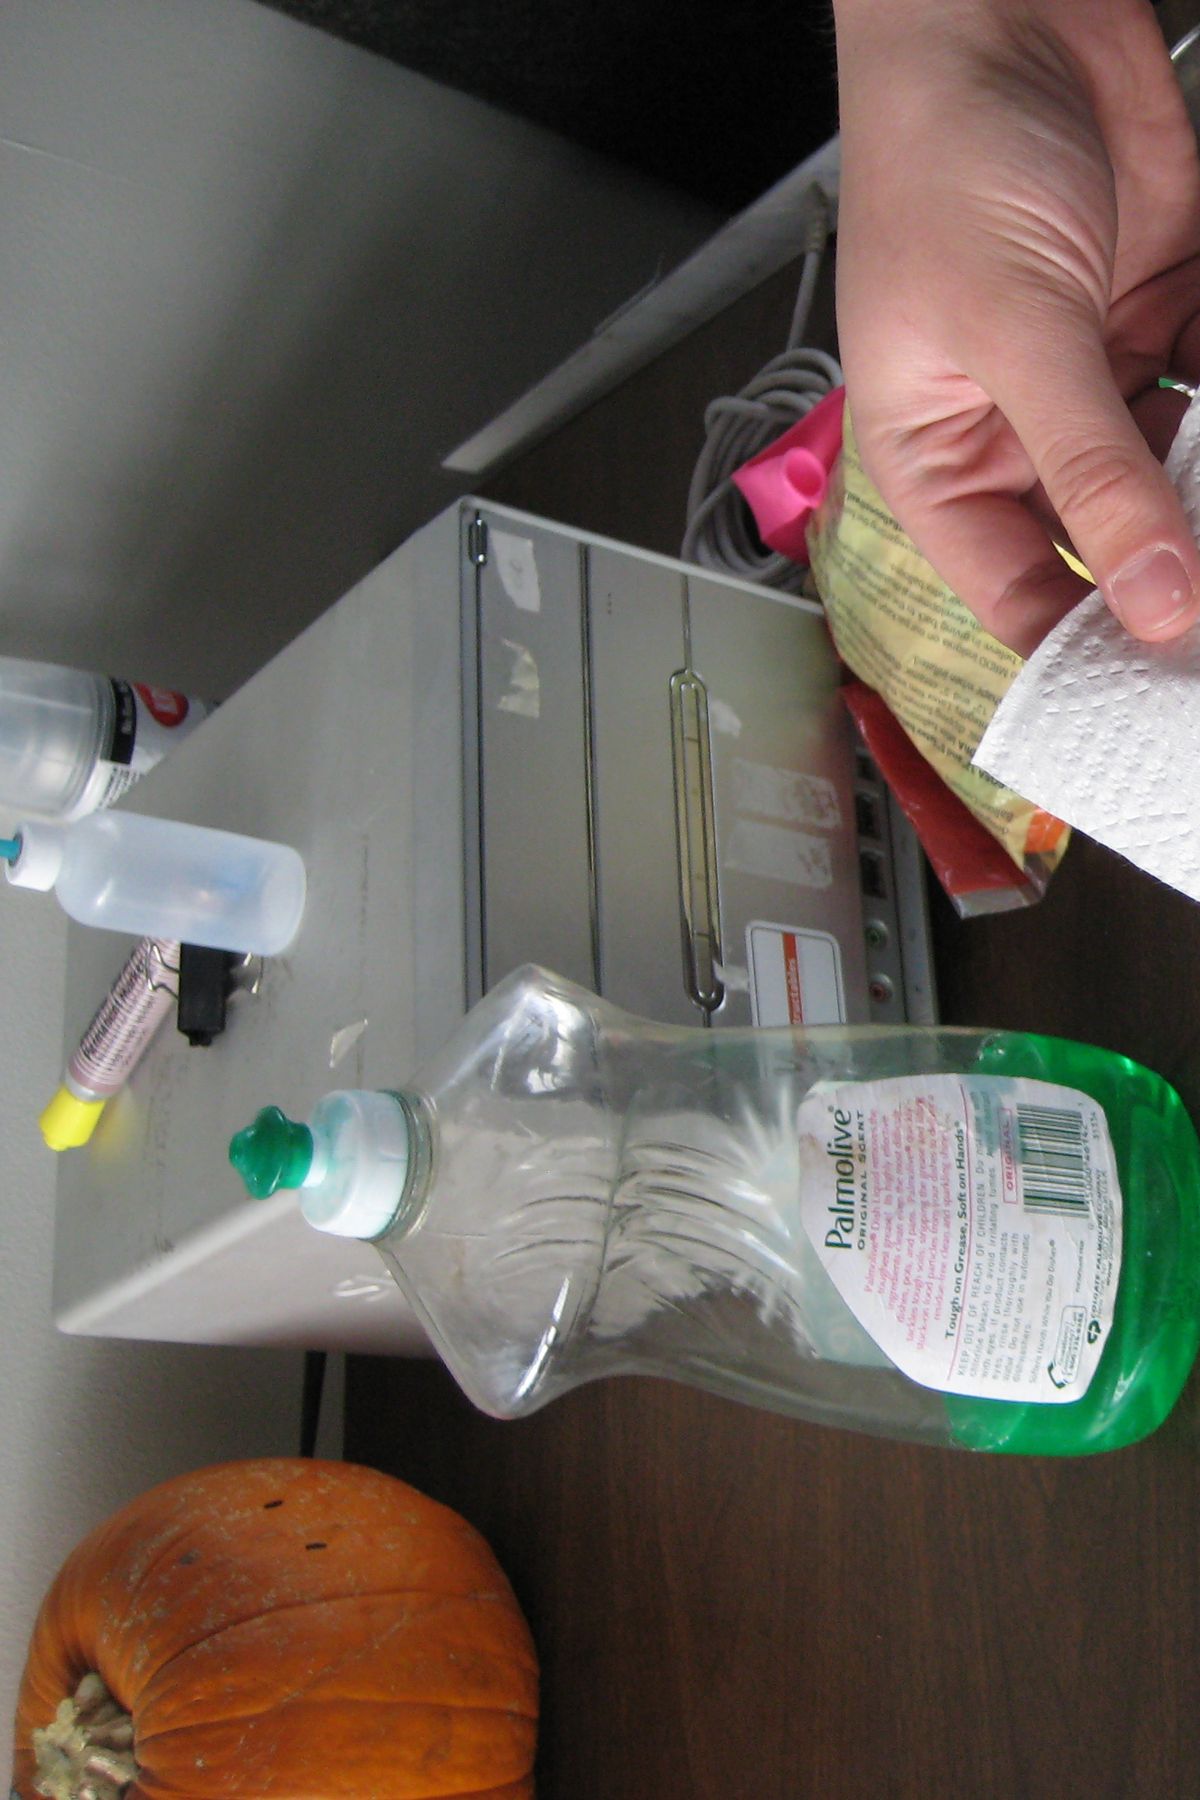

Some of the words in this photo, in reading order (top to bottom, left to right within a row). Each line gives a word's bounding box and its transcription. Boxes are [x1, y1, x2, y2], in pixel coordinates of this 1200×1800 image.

[916, 609, 940, 628] back
[868, 1108, 878, 1123] the
[856, 1108, 866, 1163] SCENT
[871, 1126, 879, 1168] removes
[917, 1126, 926, 1144] and
[975, 1137, 983, 1155] not
[918, 1148, 928, 1178] grease
[930, 1150, 938, 1181] dishes
[975, 1159, 984, 1174] Do
[1002, 1119, 1013, 1190] ORIGINAL
[824, 1108, 855, 1249] Palmolive
[871, 1170, 884, 1202] Liquid
[883, 1161, 893, 1190] highly
[919, 1181, 927, 1197] the
[941, 1161, 952, 1206] sparkling
[957, 1172, 966, 1188] on
[857, 1170, 867, 1249] ORIGINAL
[871, 1207, 880, 1229] Dish
[957, 1191, 967, 1218] Soft
[919, 1199, 930, 1243] stripping
[930, 1209, 938, 1233] from
[942, 1209, 950, 1228] and
[986, 1203, 999, 1246] irritating
[906, 1238, 914, 1257] and
[940, 1231, 949, 1258] clean
[954, 1221, 968, 1273] Grease,
[975, 1242, 985, 1256] OF
[996, 1231, 1008, 1273] contacts
[1009, 1232, 1019, 1254] with
[1018, 1232, 1031, 1280] automatic
[888, 1254, 901, 1309] ingredients
[895, 1223, 903, 1250] clean
[926, 1237, 938, 1279] particles
[985, 1251, 996, 1279] avoid
[878, 1251, 890, 1294] toughest
[953, 1276, 962, 1293] on
[970, 1262, 983, 1297] REACH
[1045, 1273, 1054, 1286] Do
[912, 1276, 924, 1303] tough
[922, 1281, 933, 1304] food
[983, 1284, 993, 1294] to
[992, 1276, 1005, 1314] product
[1003, 1260, 1019, 1316] thoroughly
[1017, 1283, 1025, 1293] in
[1044, 1286, 1053, 1301] You
[946, 1296, 962, 1339] Tough
[967, 1303, 977, 1317] OF
[978, 1299, 990, 1332] bleach
[1014, 1296, 1024, 1313] use
[1040, 1303, 1051, 1327] While
[906, 1306, 918, 1340] tackles
[963, 1322, 974, 1343] OUT
[997, 1322, 1008, 1348] rinse
[1011, 1317, 1021, 1332] not
[1007, 1335, 1018, 1349] Do
[957, 1349, 970, 1376] KEEP
[969, 1337, 984, 1377] chlorine
[981, 1358, 992, 1377] with
[1029, 1354, 1043, 1382] Softens
